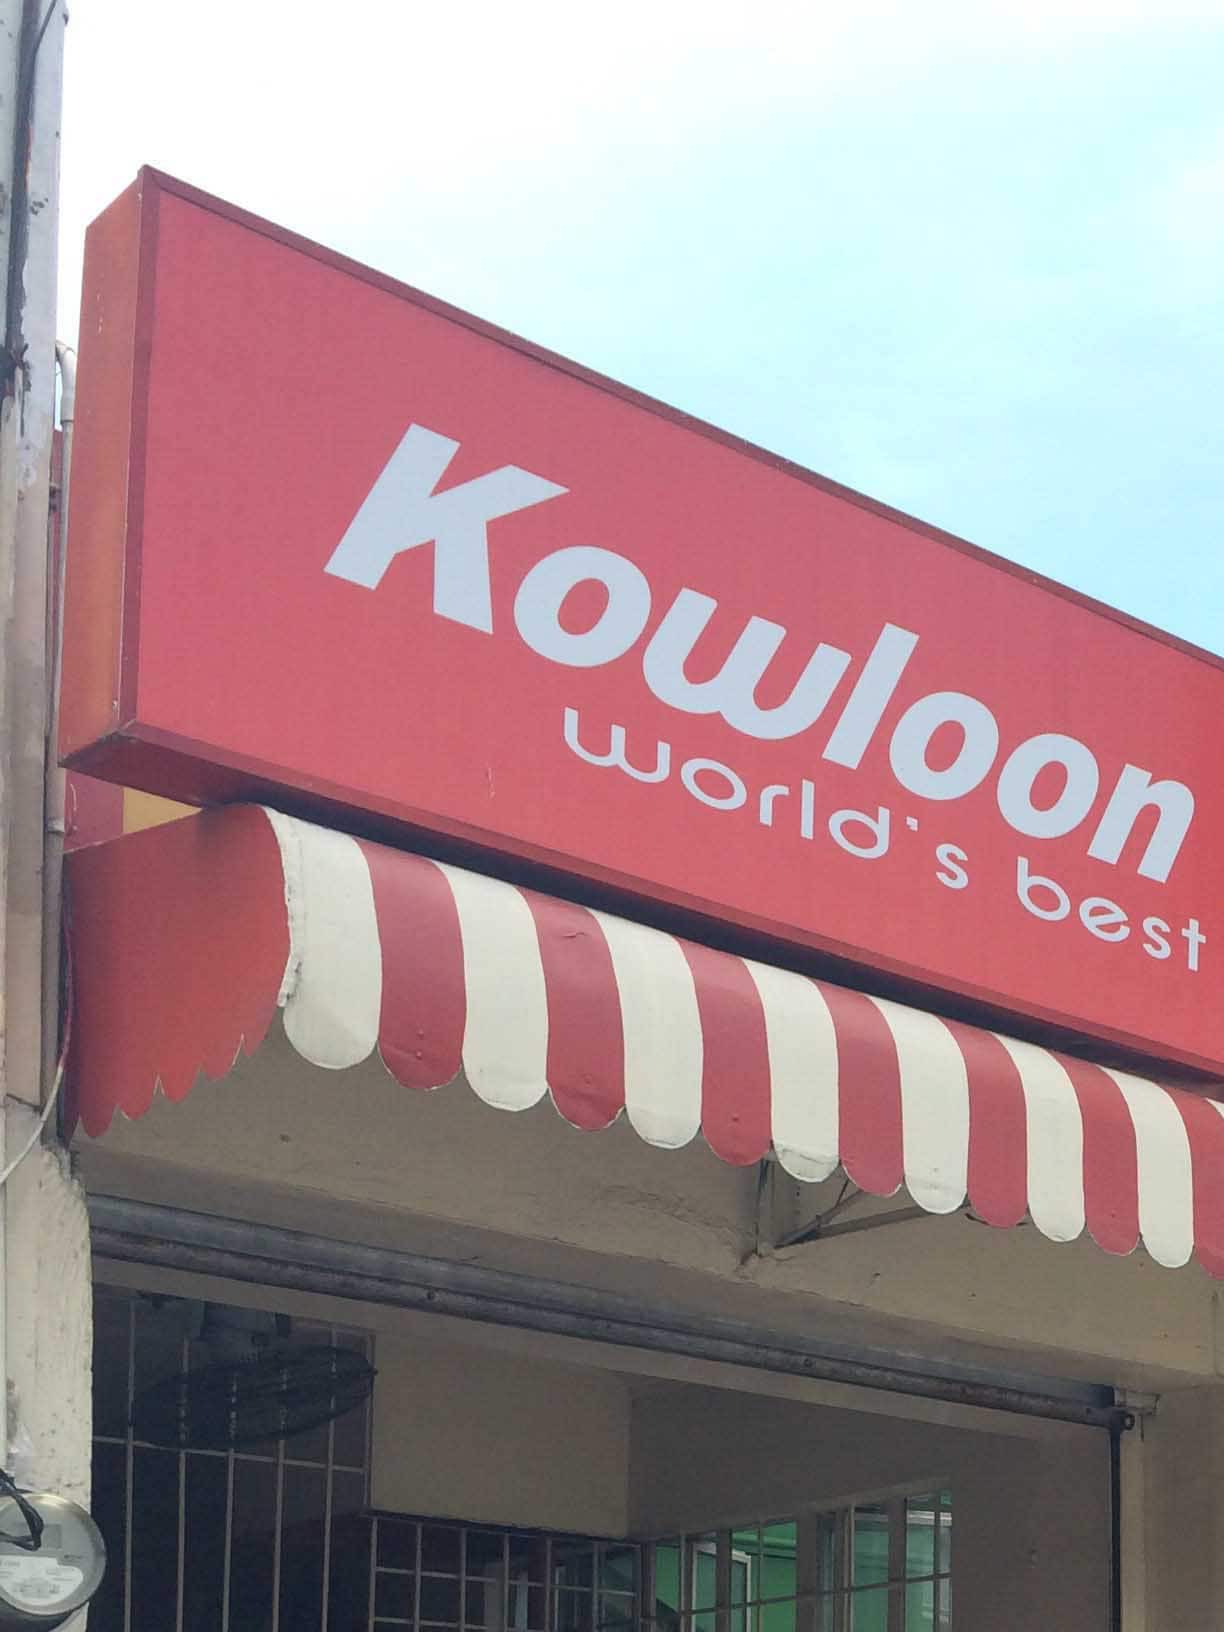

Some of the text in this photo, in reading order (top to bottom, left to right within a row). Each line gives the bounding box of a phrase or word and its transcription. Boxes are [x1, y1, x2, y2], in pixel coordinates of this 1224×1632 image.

[324, 423, 1195, 884] Kowloon
[564, 706, 970, 889] world's
[1017, 856, 1207, 972] best
